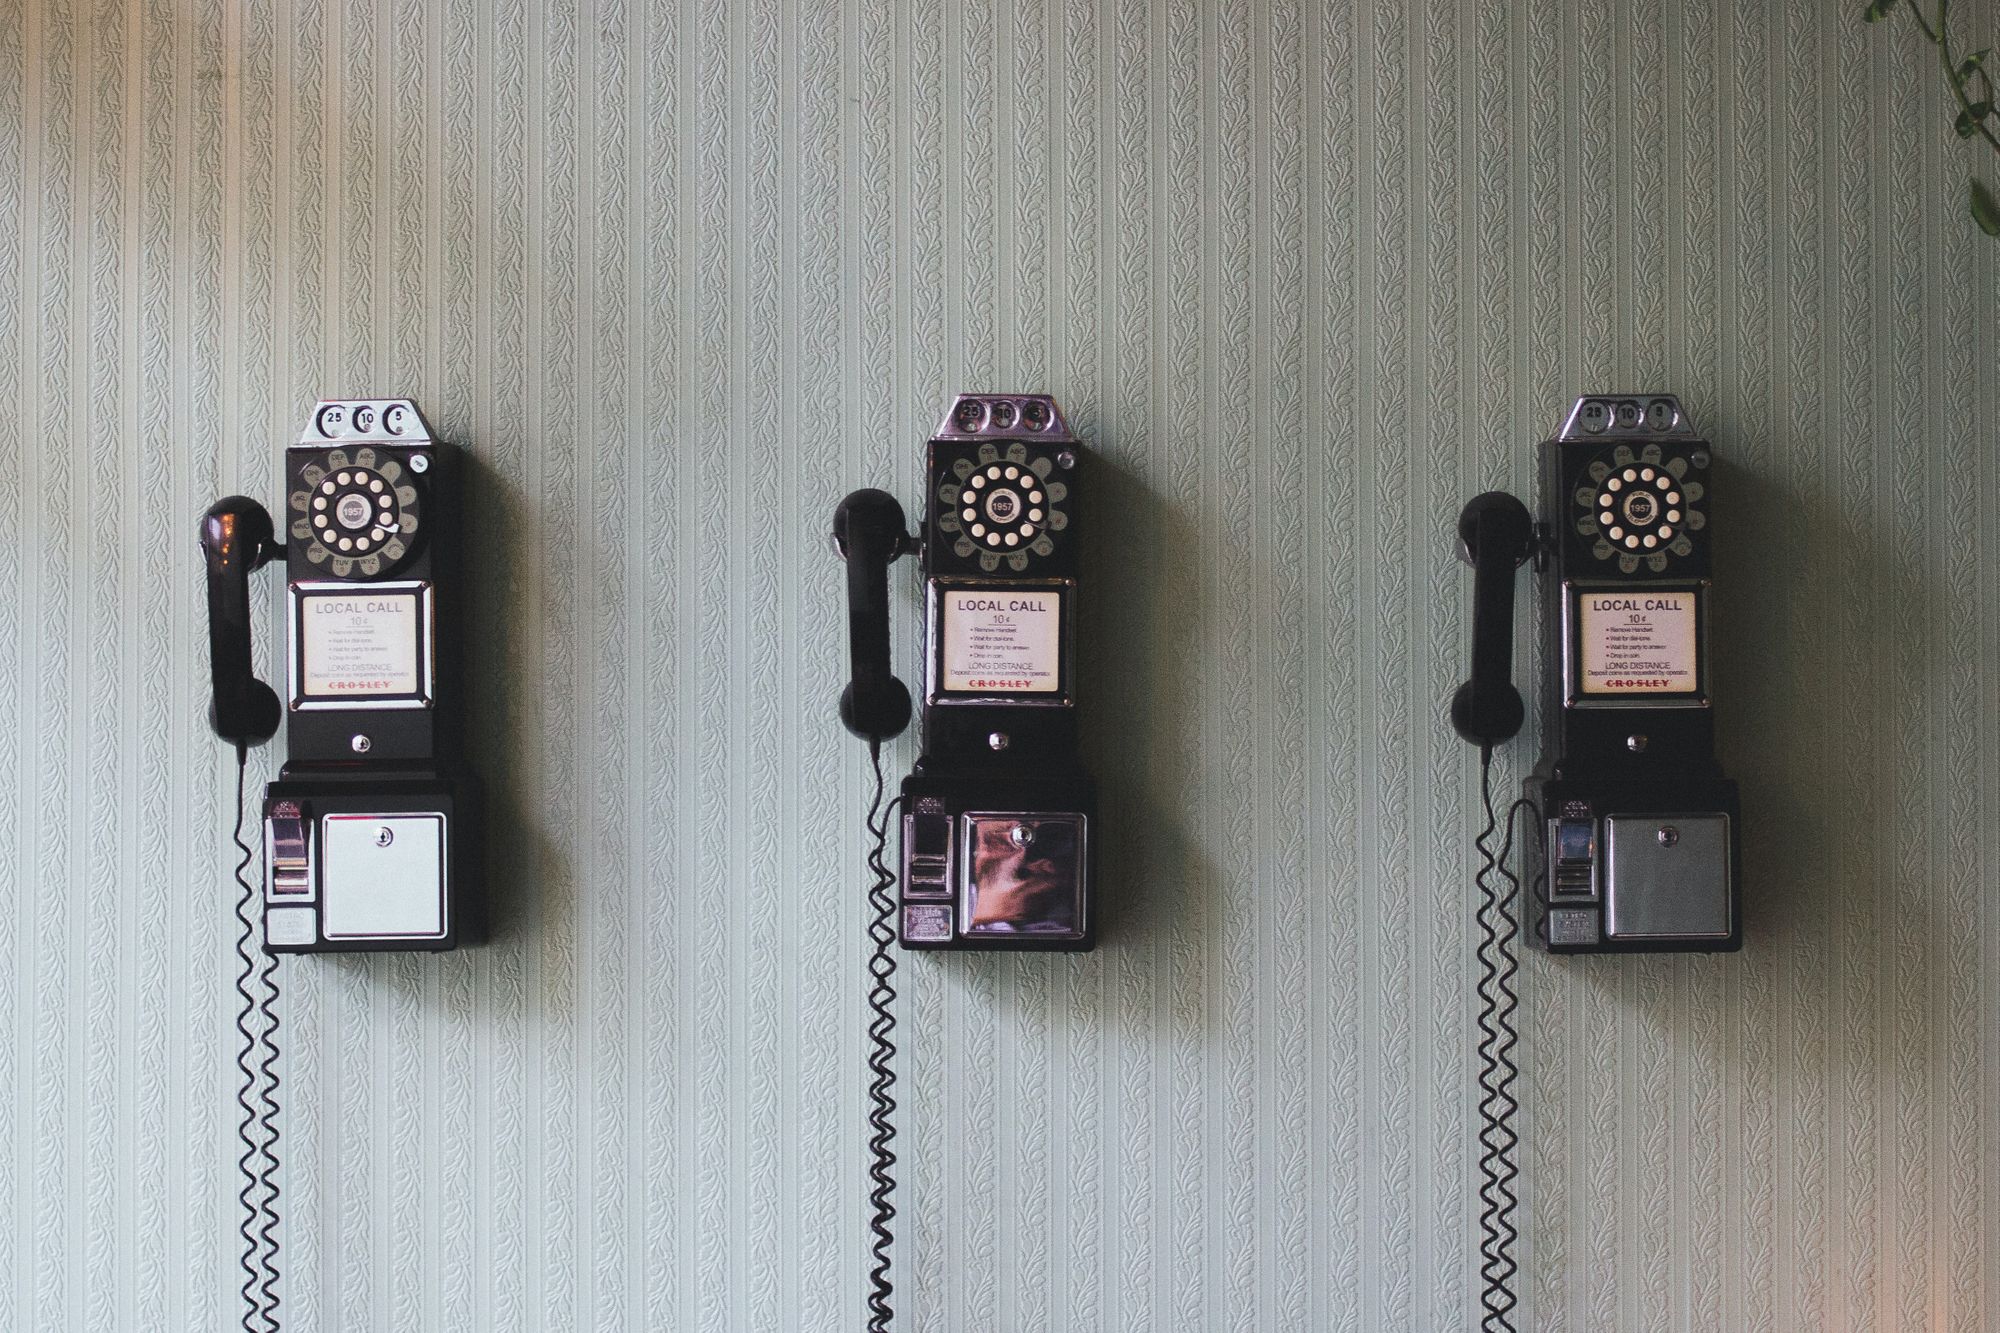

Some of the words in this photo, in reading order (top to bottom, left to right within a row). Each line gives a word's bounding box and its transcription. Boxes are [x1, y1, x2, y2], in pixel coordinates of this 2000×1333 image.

[395, 411, 402, 421] 5
[1586, 406, 1602, 417] 25
[1621, 408, 1635, 419] 10
[327, 412, 342, 422] 25
[361, 413, 374, 423] 10
[991, 502, 1013, 511] 1957
[1631, 504, 1651, 513] 1957
[343, 507, 363, 516] 1957
[316, 603, 362, 614] LOCAL
[366, 602, 403, 613] CALL
[958, 600, 1005, 611] LOCAL
[1009, 601, 1046, 612] CALL
[1593, 600, 1640, 611] LOCAL
[1645, 600, 1682, 611] CALL
[328, 664, 350, 672] LONG
[352, 663, 392, 671] DISTANCE
[968, 662, 991, 670] LONG
[1605, 661, 1628, 670] LONG
[1629, 661, 1671, 669] DISTANCE
[1588, 669, 1608, 677] Deposit
[1631, 669, 1658, 677] requested
[328, 680, 392, 689] CROSLEY
[968, 679, 1032, 688] CROSLEY
[1605, 679, 1670, 688] CROSLEY
